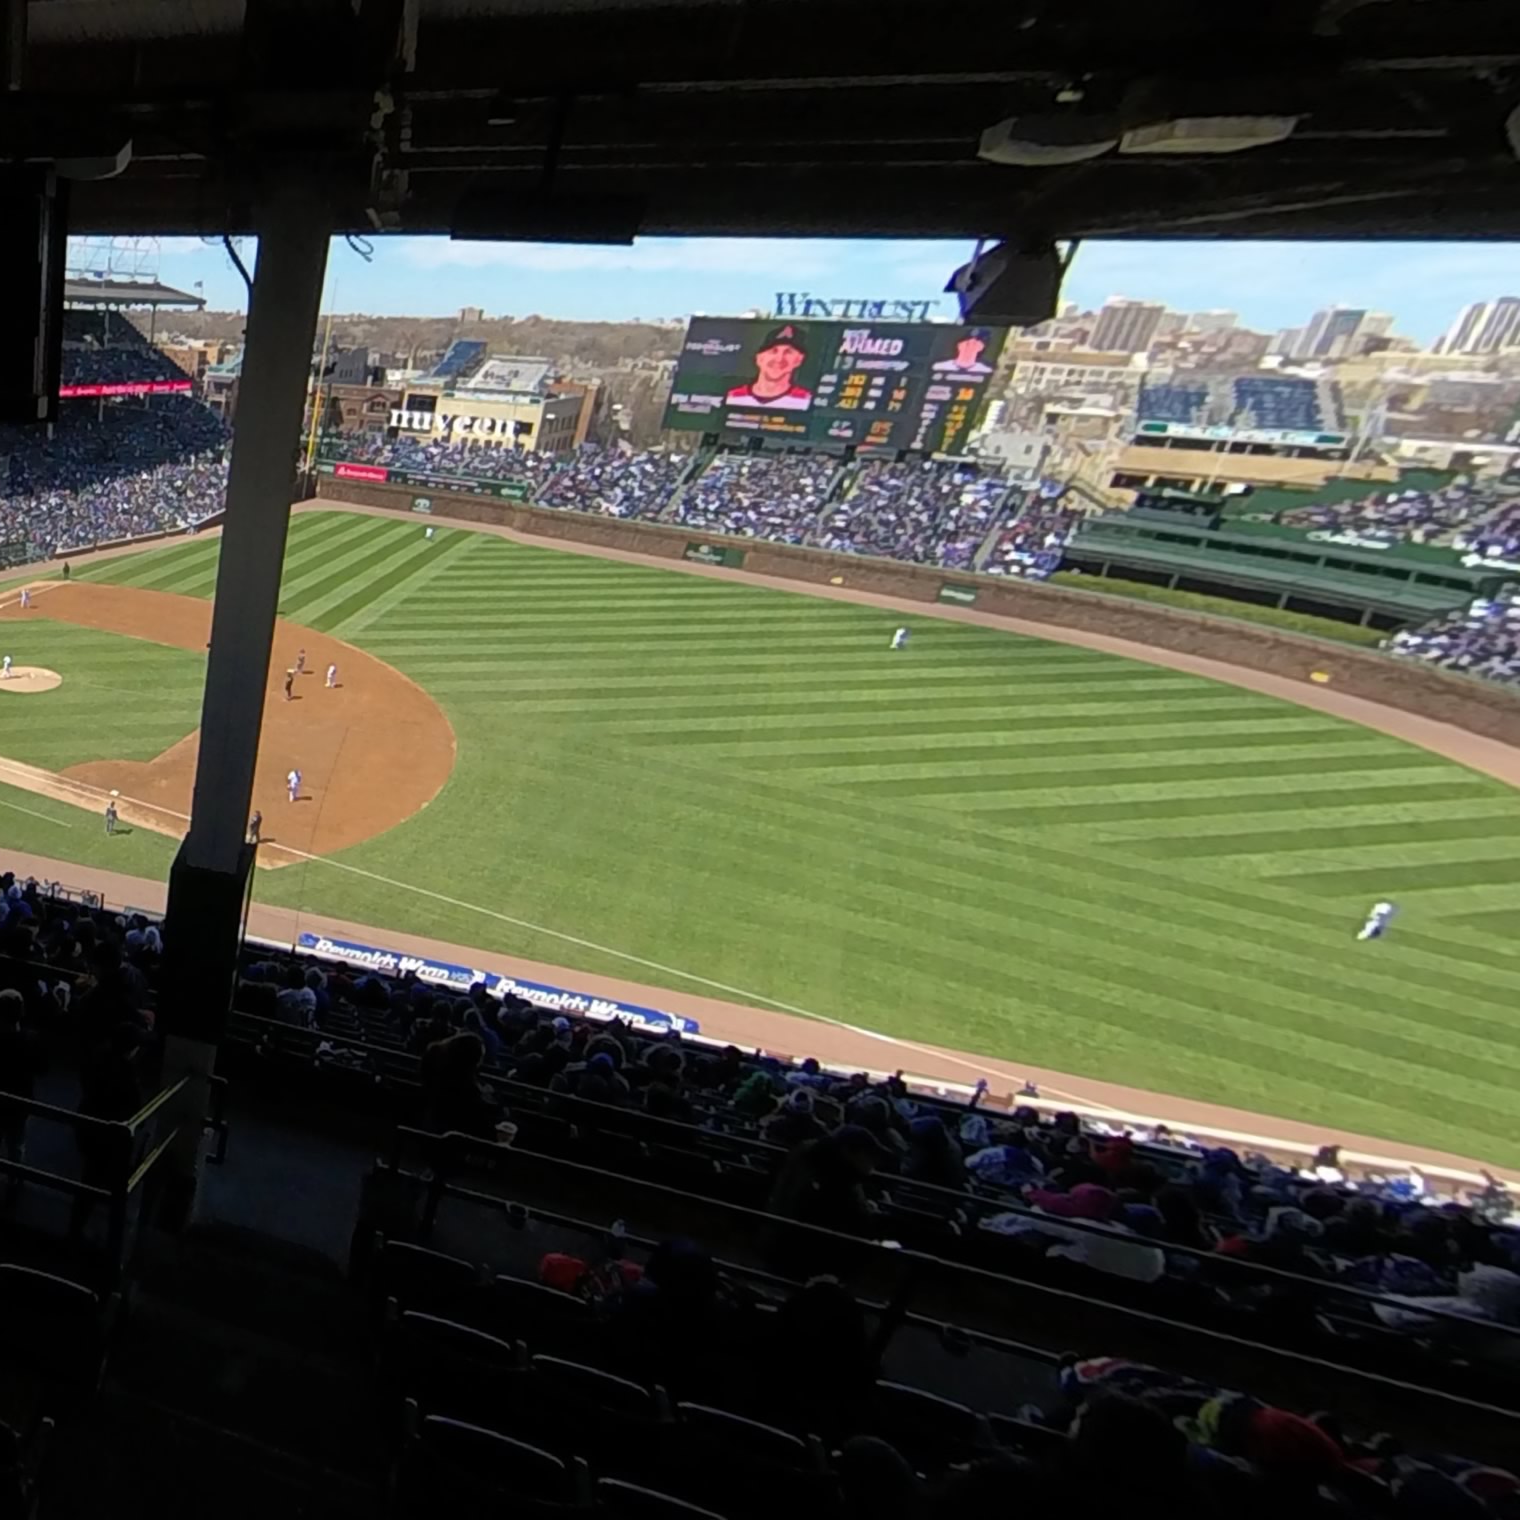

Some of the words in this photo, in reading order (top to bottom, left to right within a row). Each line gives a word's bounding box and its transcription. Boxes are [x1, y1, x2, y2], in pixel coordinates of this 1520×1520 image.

[839, 336, 904, 356] AHMED
[389, 409, 517, 439] nuveen
[314, 937, 398, 968] Reynolds
[495, 975, 590, 1011] Reynolds
